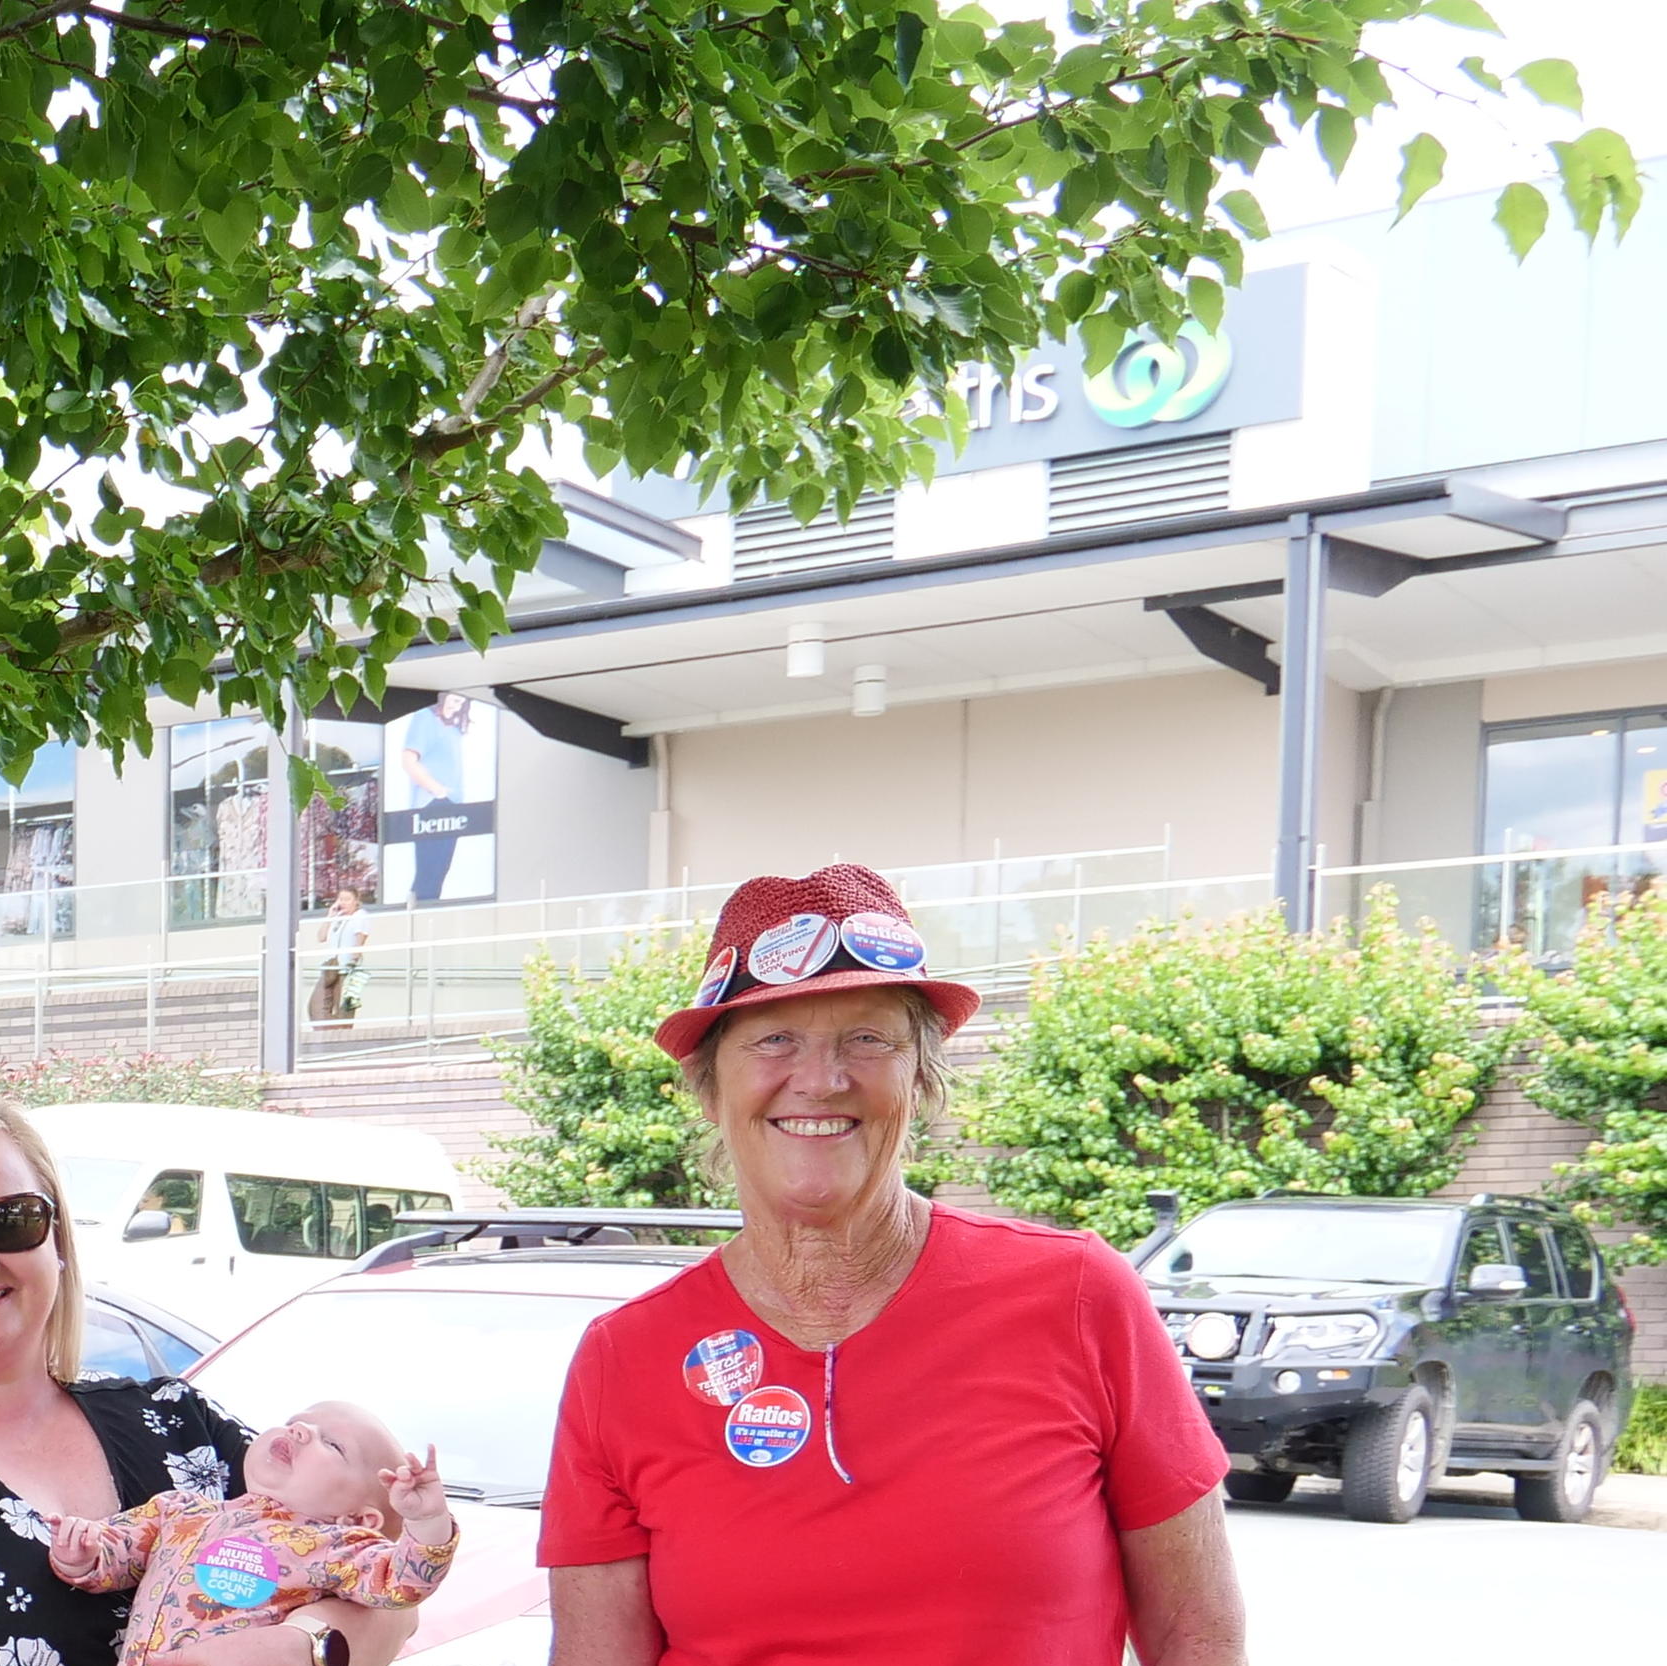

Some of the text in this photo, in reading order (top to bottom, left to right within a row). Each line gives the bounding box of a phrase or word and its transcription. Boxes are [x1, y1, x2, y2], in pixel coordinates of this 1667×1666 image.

[412, 813, 468, 835] beme
[759, 961, 784, 977] NOW
[737, 1403, 803, 1426] Ratios
[218, 1546, 264, 1564] MUMS
[206, 1554, 268, 1578] MATTER.
[209, 1567, 258, 1588] BABIES
[207, 1578, 256, 1599] COUNT
